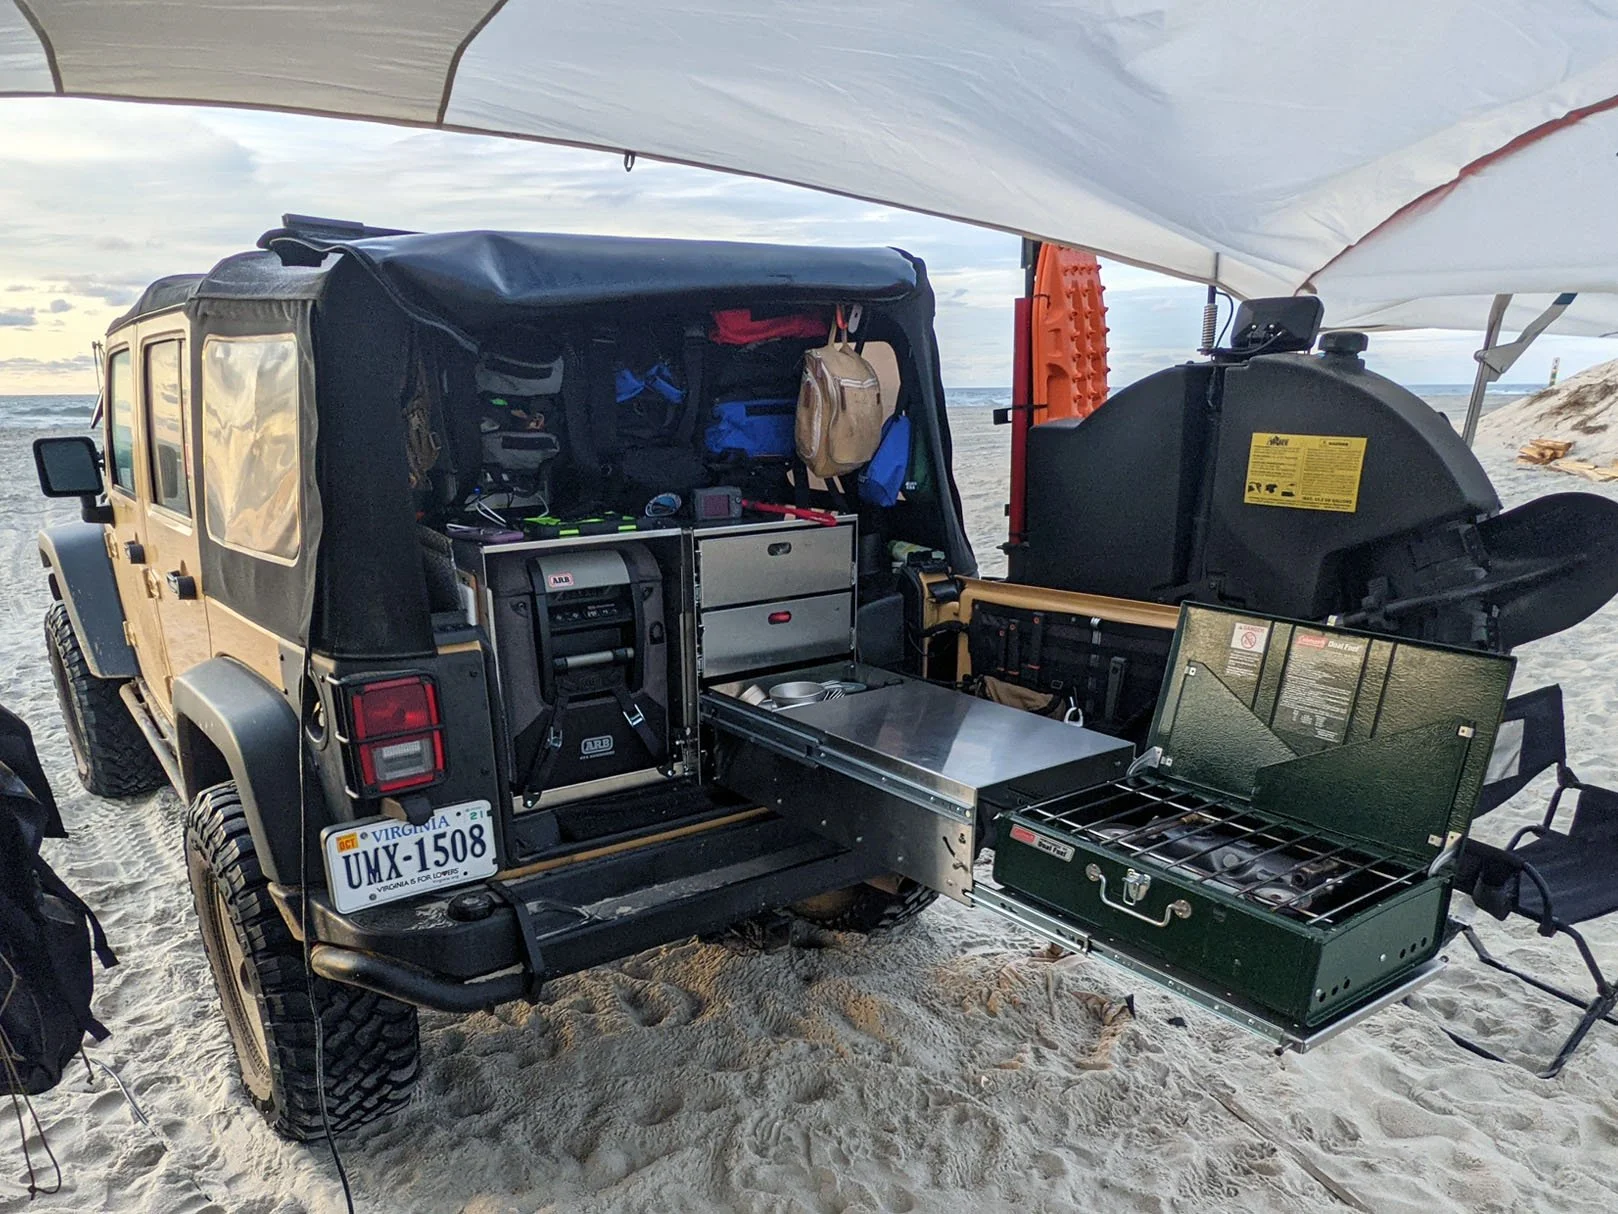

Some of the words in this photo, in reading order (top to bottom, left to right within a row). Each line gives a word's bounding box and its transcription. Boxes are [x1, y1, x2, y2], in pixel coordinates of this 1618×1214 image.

[553, 576, 570, 584] ARB
[1327, 640, 1344, 649] Dual
[1343, 643, 1359, 651] Fuel
[585, 738, 610, 751] ARB
[371, 816, 450, 843] VIRGINIA
[339, 836, 355, 847] OCT
[1038, 841, 1052, 851] Dual
[1052, 847, 1067, 857] Fuel
[342, 823, 487, 890] UMX-1508
[377, 881, 409, 893] VIRGINIA
[417, 874, 432, 884] FOR
[433, 868, 459, 879] LOVERS
